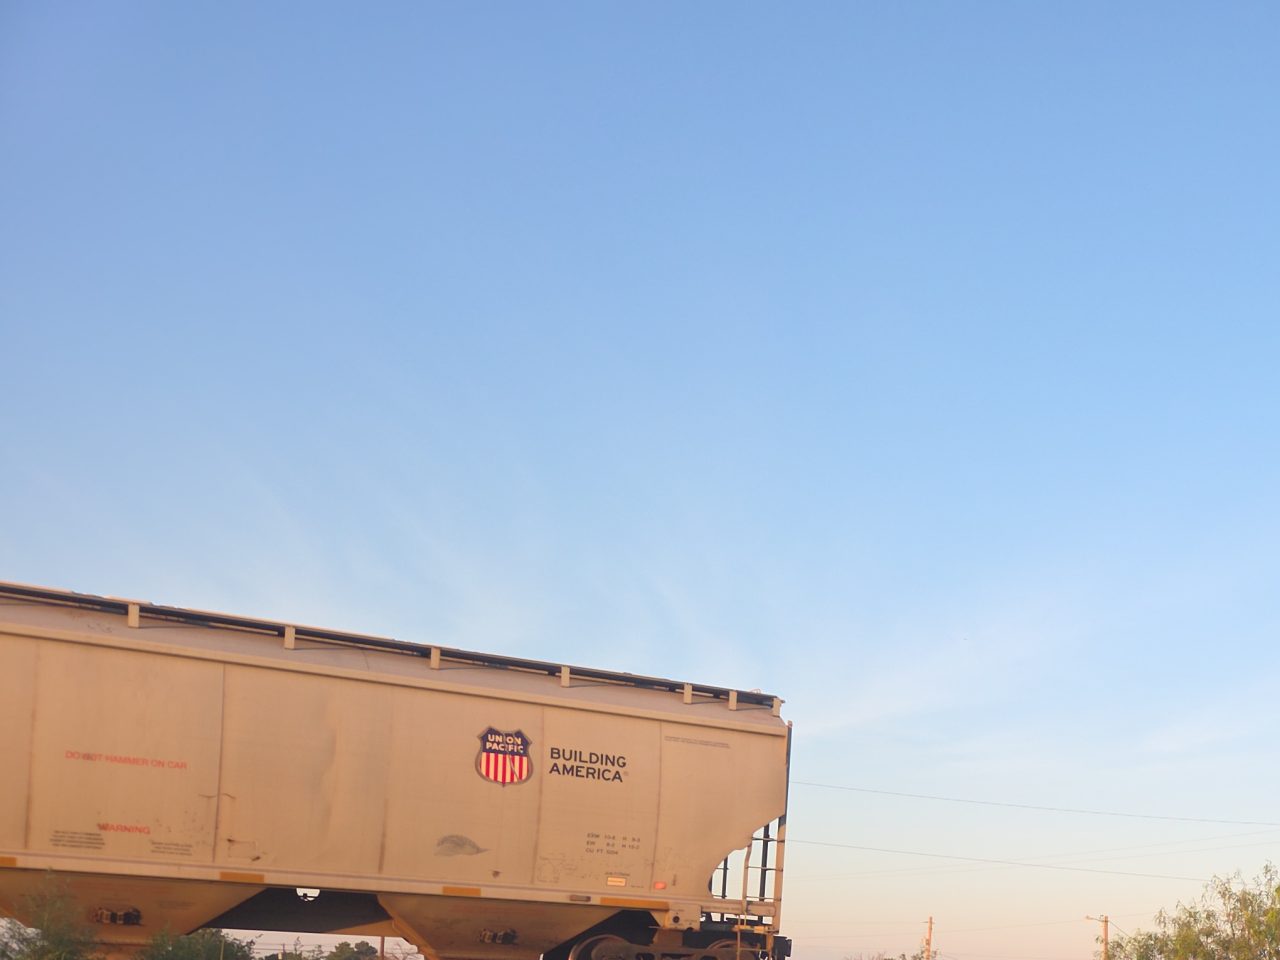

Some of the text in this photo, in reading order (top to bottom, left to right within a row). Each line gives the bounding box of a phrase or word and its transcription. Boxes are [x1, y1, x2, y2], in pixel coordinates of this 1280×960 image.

[485, 741, 524, 754] PACIFIC
[550, 747, 627, 768] BUILDING
[64, 750, 188, 770] DO NOT HAMMER ON CAR
[549, 762, 623, 783] AMERICA
[97, 822, 151, 835] WARNING
